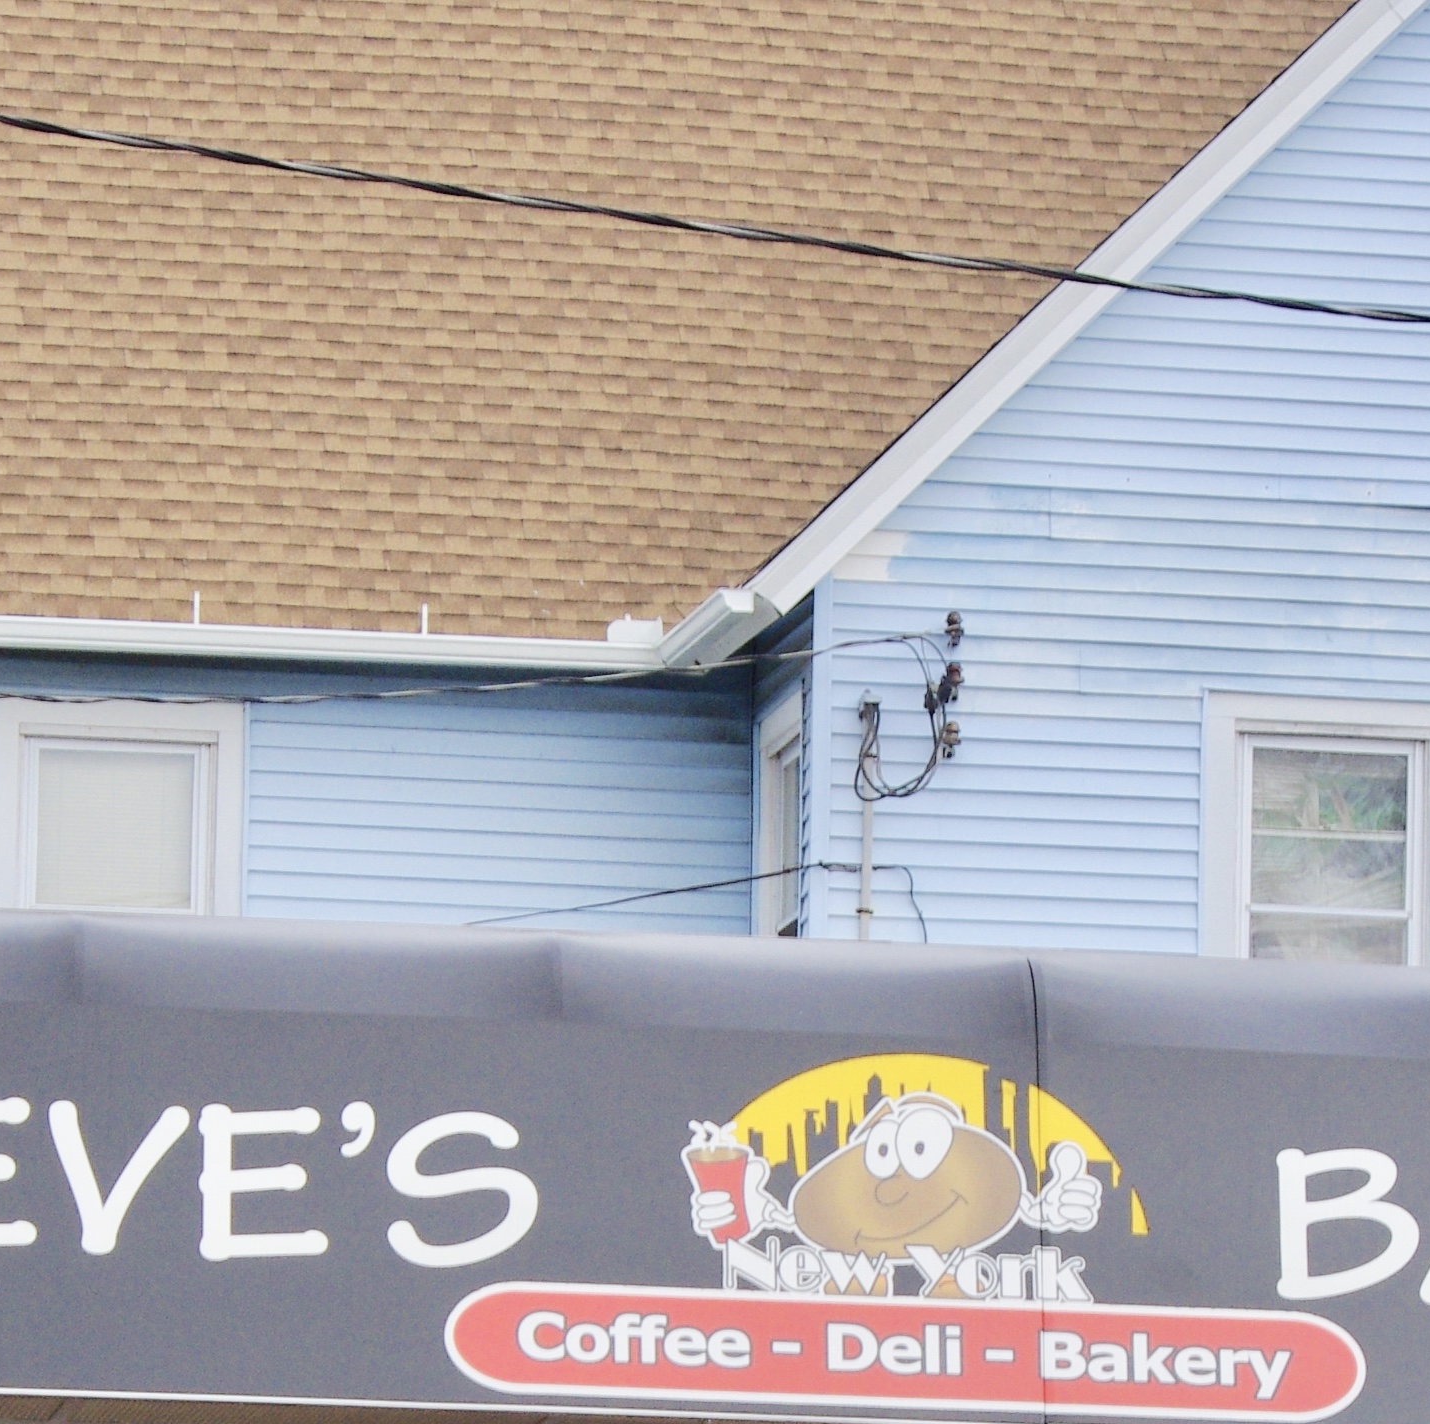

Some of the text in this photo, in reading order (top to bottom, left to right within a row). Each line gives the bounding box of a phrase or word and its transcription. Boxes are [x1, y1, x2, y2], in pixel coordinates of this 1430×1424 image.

[725, 1236, 1094, 1300] New York
[516, 1310, 753, 1369] Coffee
[825, 1321, 964, 1376] Deli
[1038, 1330, 1293, 1400] Bakery
